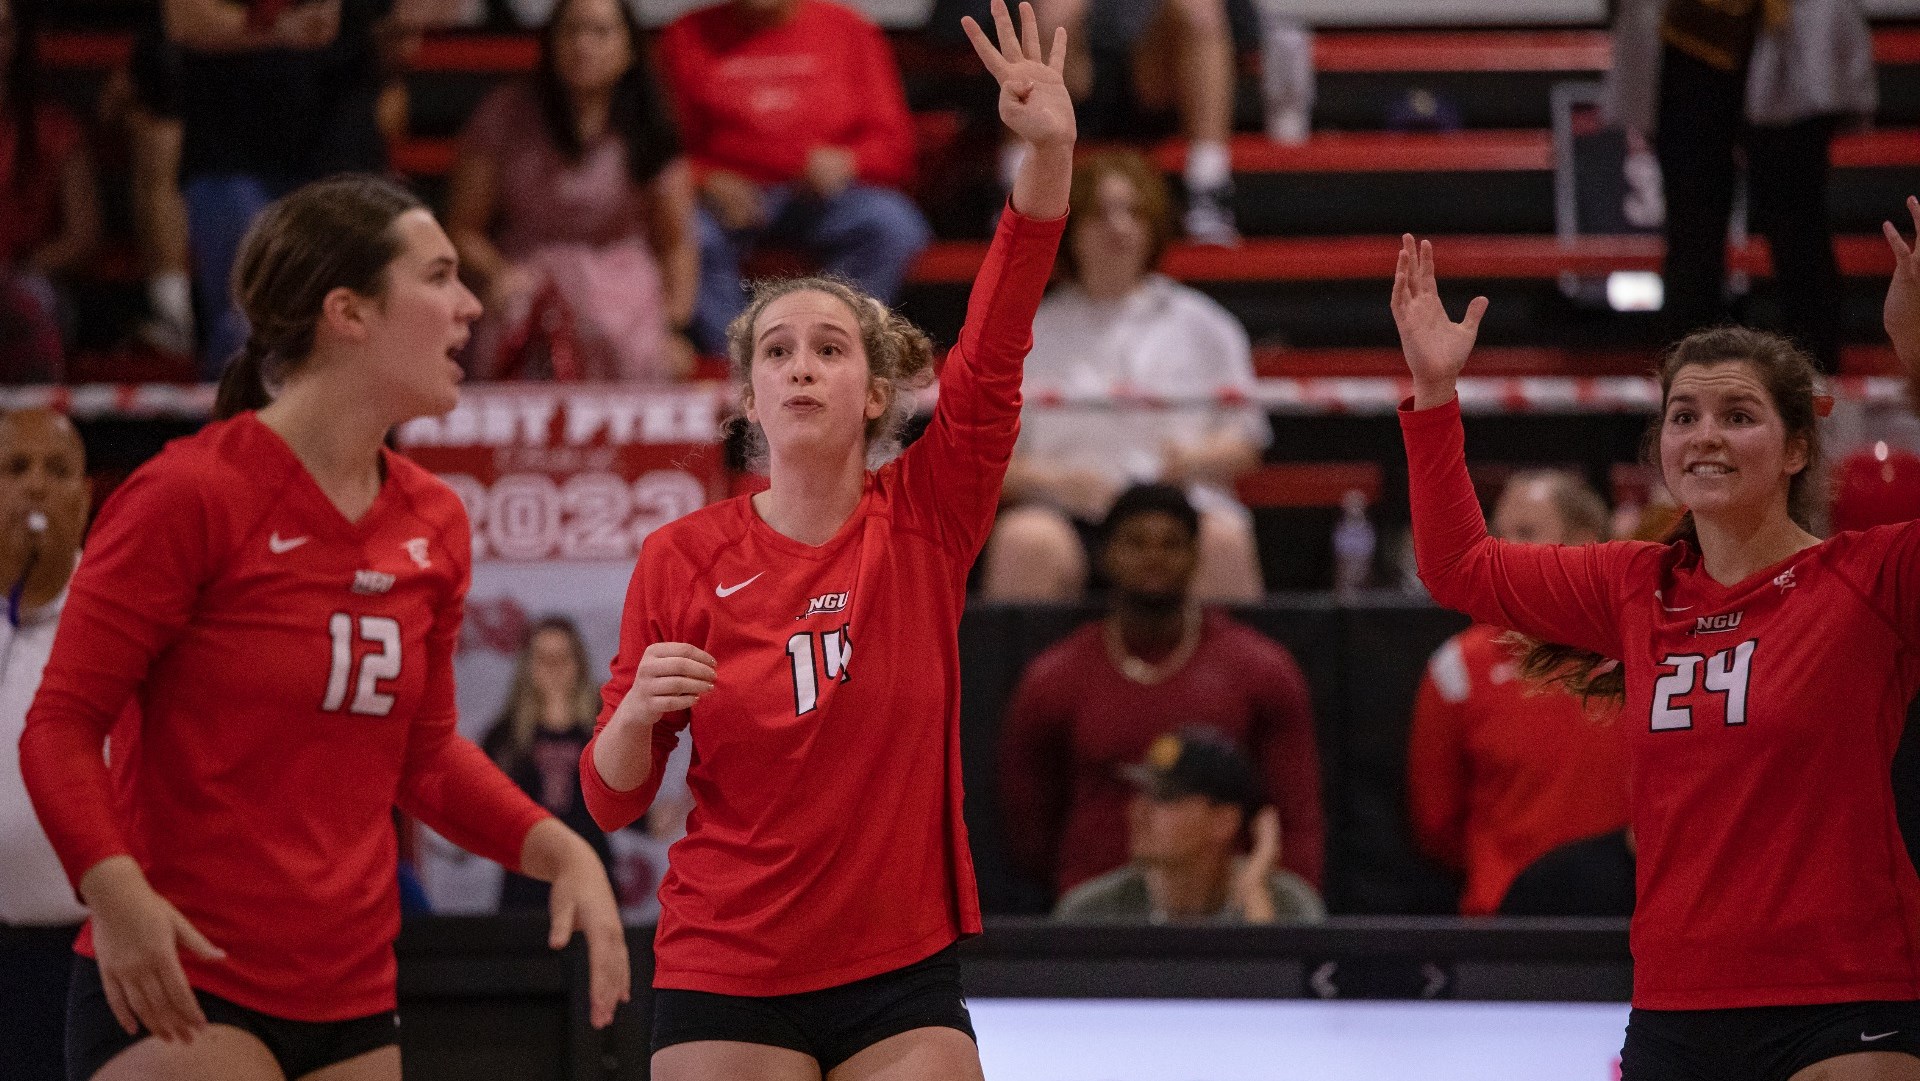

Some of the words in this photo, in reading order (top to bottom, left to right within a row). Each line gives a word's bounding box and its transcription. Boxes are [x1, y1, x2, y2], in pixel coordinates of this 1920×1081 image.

[806, 590, 850, 614] NGU
[1696, 611, 1744, 632] NGU
[320, 611, 402, 717] 12
[785, 622, 853, 717] 14
[1649, 637, 1759, 733] 24
